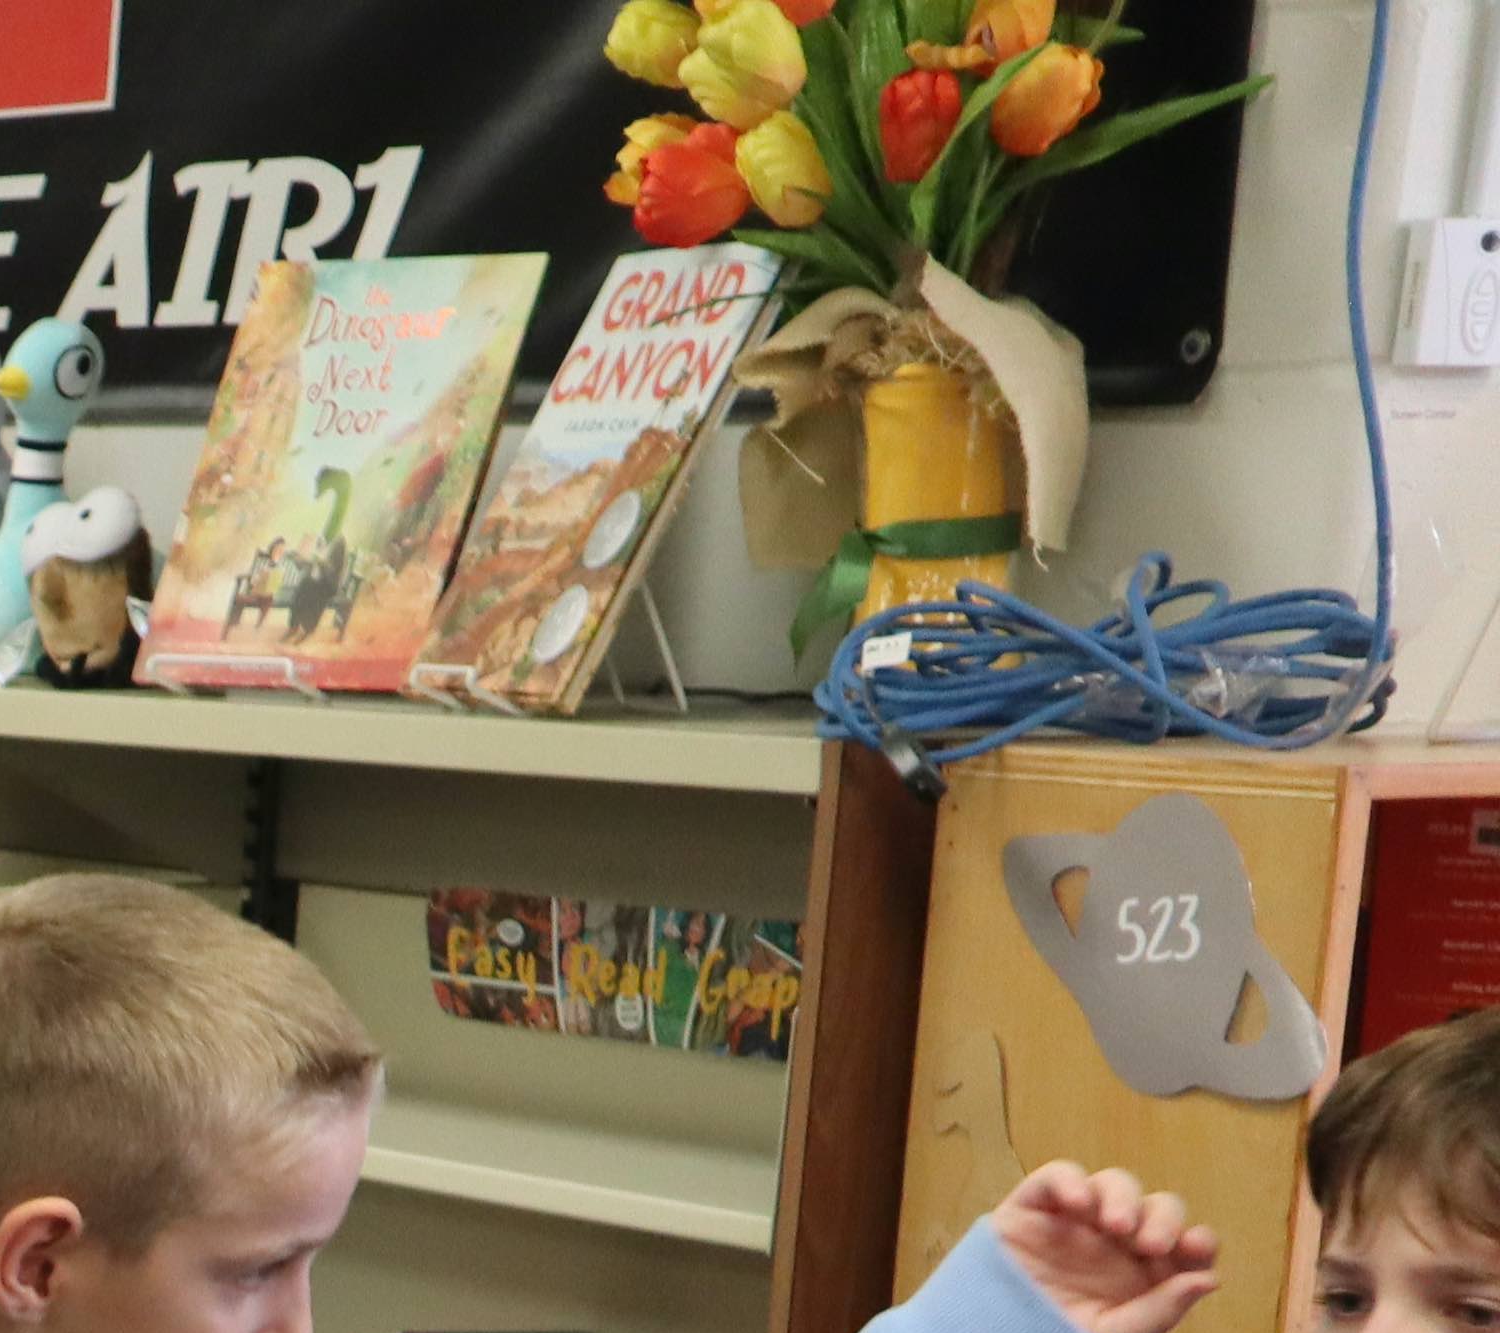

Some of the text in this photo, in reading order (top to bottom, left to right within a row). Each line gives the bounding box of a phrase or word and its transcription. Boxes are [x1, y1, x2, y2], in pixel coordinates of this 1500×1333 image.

[304, 296, 456, 352] Dinosaur
[603, 262, 745, 331] GRAND
[308, 347, 397, 403] Next
[552, 336, 731, 404] CANYON
[313, 400, 389, 437] Door
[1116, 894, 1202, 963] 523
[448, 926, 537, 1005] Easy
[568, 946, 668, 1007] Read
